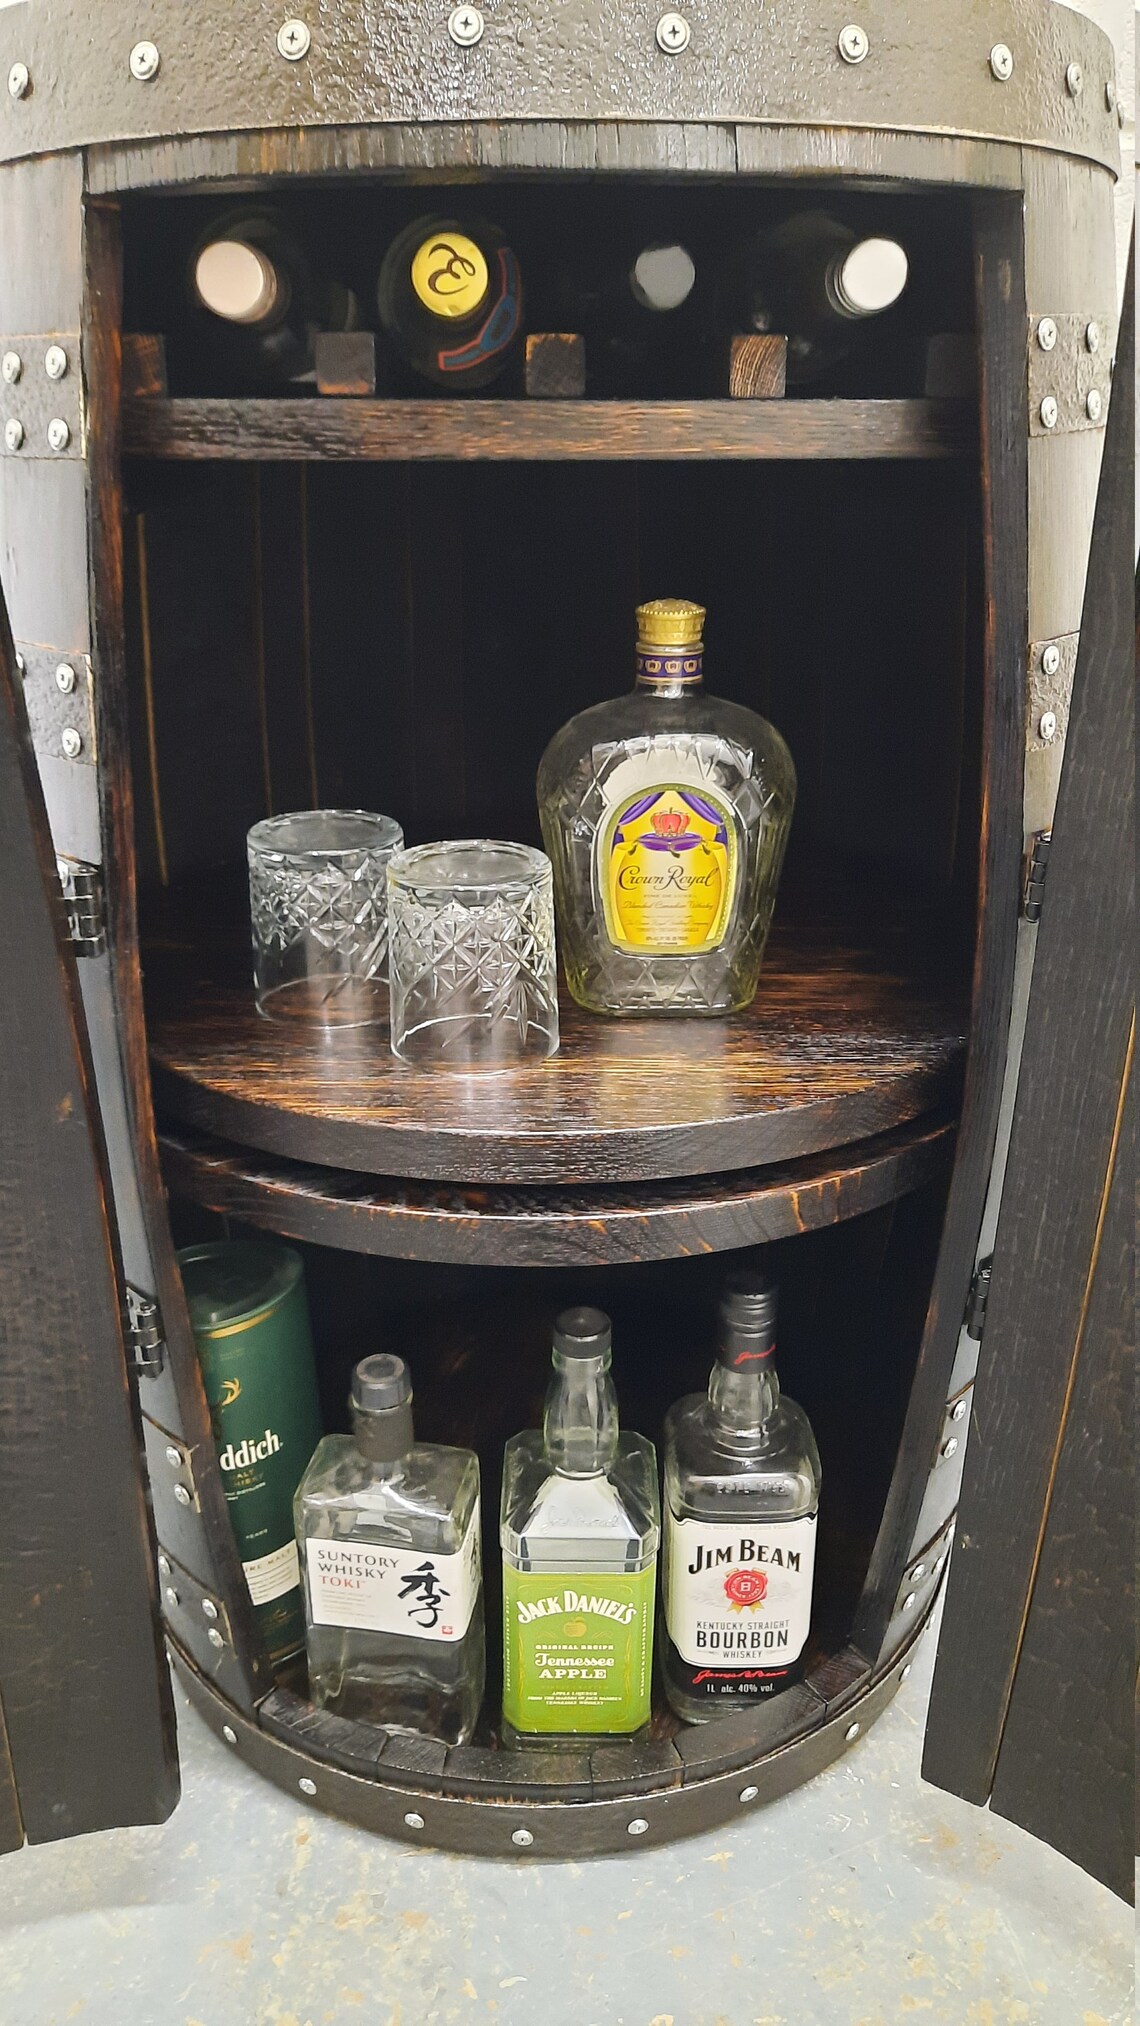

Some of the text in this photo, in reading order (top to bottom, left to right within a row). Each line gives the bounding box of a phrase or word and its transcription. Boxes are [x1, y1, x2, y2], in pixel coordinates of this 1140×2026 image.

[618, 865, 719, 891] Crown Royal
[318, 1549, 400, 1568] SUNTORY
[688, 1538, 801, 1575] JIM BEAM
[318, 1562, 386, 1580] WHISKY
[319, 1574, 361, 1589] TOKI
[397, 1561, 450, 1628] 季
[516, 1590, 637, 1625] JACK DANIEL'S
[696, 1619, 790, 1630] KENTUCKY STRAIGHT
[696, 1629, 788, 1648] BOURBON
[535, 1652, 615, 1667] Tennessee
[723, 1650, 763, 1659] WHISKEY
[538, 1669, 607, 1679] APPLE
[706, 1683, 715, 1692] 1L
[738, 1683, 758, 1693] 40%
[760, 1683, 775, 1692] vol.
